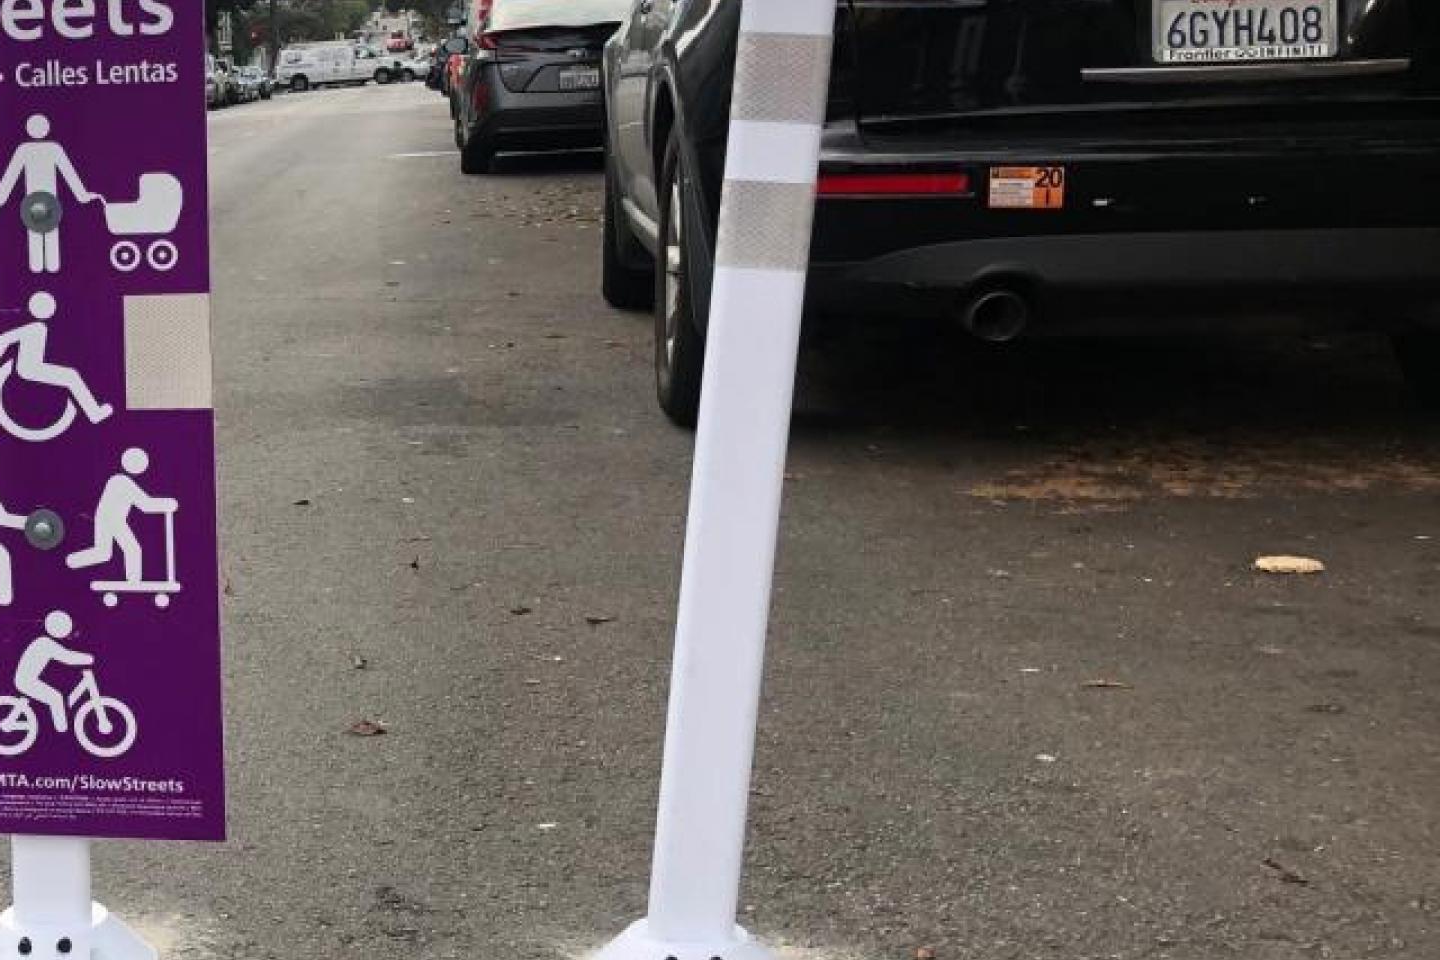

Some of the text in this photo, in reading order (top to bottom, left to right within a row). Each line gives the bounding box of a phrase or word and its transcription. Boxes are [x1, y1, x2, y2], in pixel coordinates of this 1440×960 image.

[1167, 7, 1322, 49] 6GYH408
[15, 58, 178, 87] Calles Lentas
[1035, 168, 1063, 188] 20
